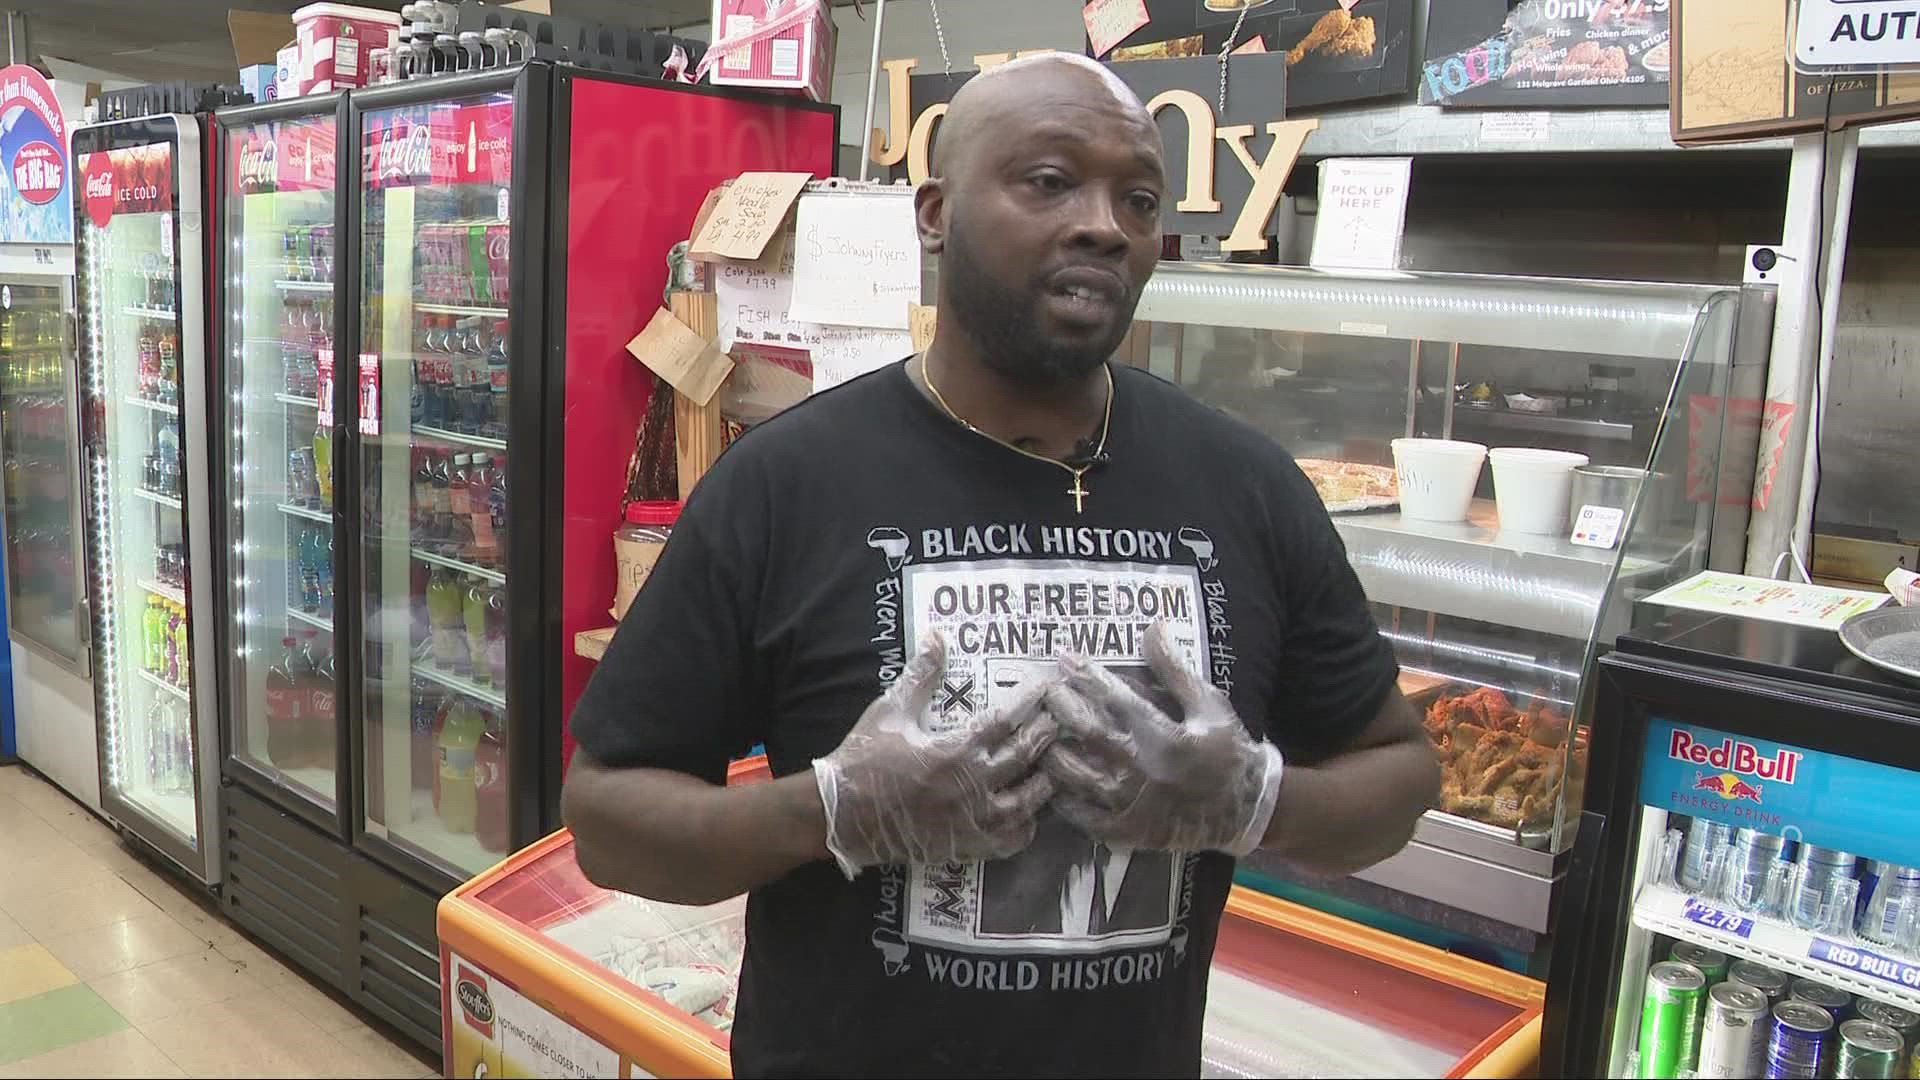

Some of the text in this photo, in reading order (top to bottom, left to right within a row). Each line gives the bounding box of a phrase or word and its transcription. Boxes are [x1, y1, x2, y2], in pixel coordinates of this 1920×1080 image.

[1544, 0, 1599, 24] Only
[1546, 27, 1571, 38] Fries
[1585, 28, 1650, 39] Chicken dinner
[1536, 63, 1562, 72] Whole
[1567, 78, 1600, 87] Garfield
[1600, 77, 1618, 85] Ohio
[20, 75, 62, 137] Homemade
[1807, 86, 1824, 96] OF
[478, 140, 491, 150] ice
[491, 137, 507, 150] cold
[28, 158, 44, 190] BIG
[43, 160, 60, 189] BAG
[117, 185, 158, 201] ICE COLD
[1331, 185, 1395, 197] PICK UP
[1339, 198, 1382, 209] HERE
[738, 304, 771, 324] FISH
[921, 523, 1174, 560] BLACK HISTORY
[870, 577, 901, 642] Every
[934, 582, 1188, 618] OUR FREEDOM
[1203, 578, 1232, 639] Black
[958, 620, 1059, 655] CAN'T
[1668, 728, 1797, 784] Red Bull
[1671, 791, 1782, 825] ENERGY DRINK
[925, 950, 1168, 991] WORLD HISTORY
[1827, 945, 1860, 969] RED
[1860, 955, 1900, 982] BULL
[497, 1016, 527, 1042] NOTHING
[527, 1034, 549, 1057] COMES
[550, 1050, 575, 1073] CLOSER
[575, 1064, 586, 1079] TO
